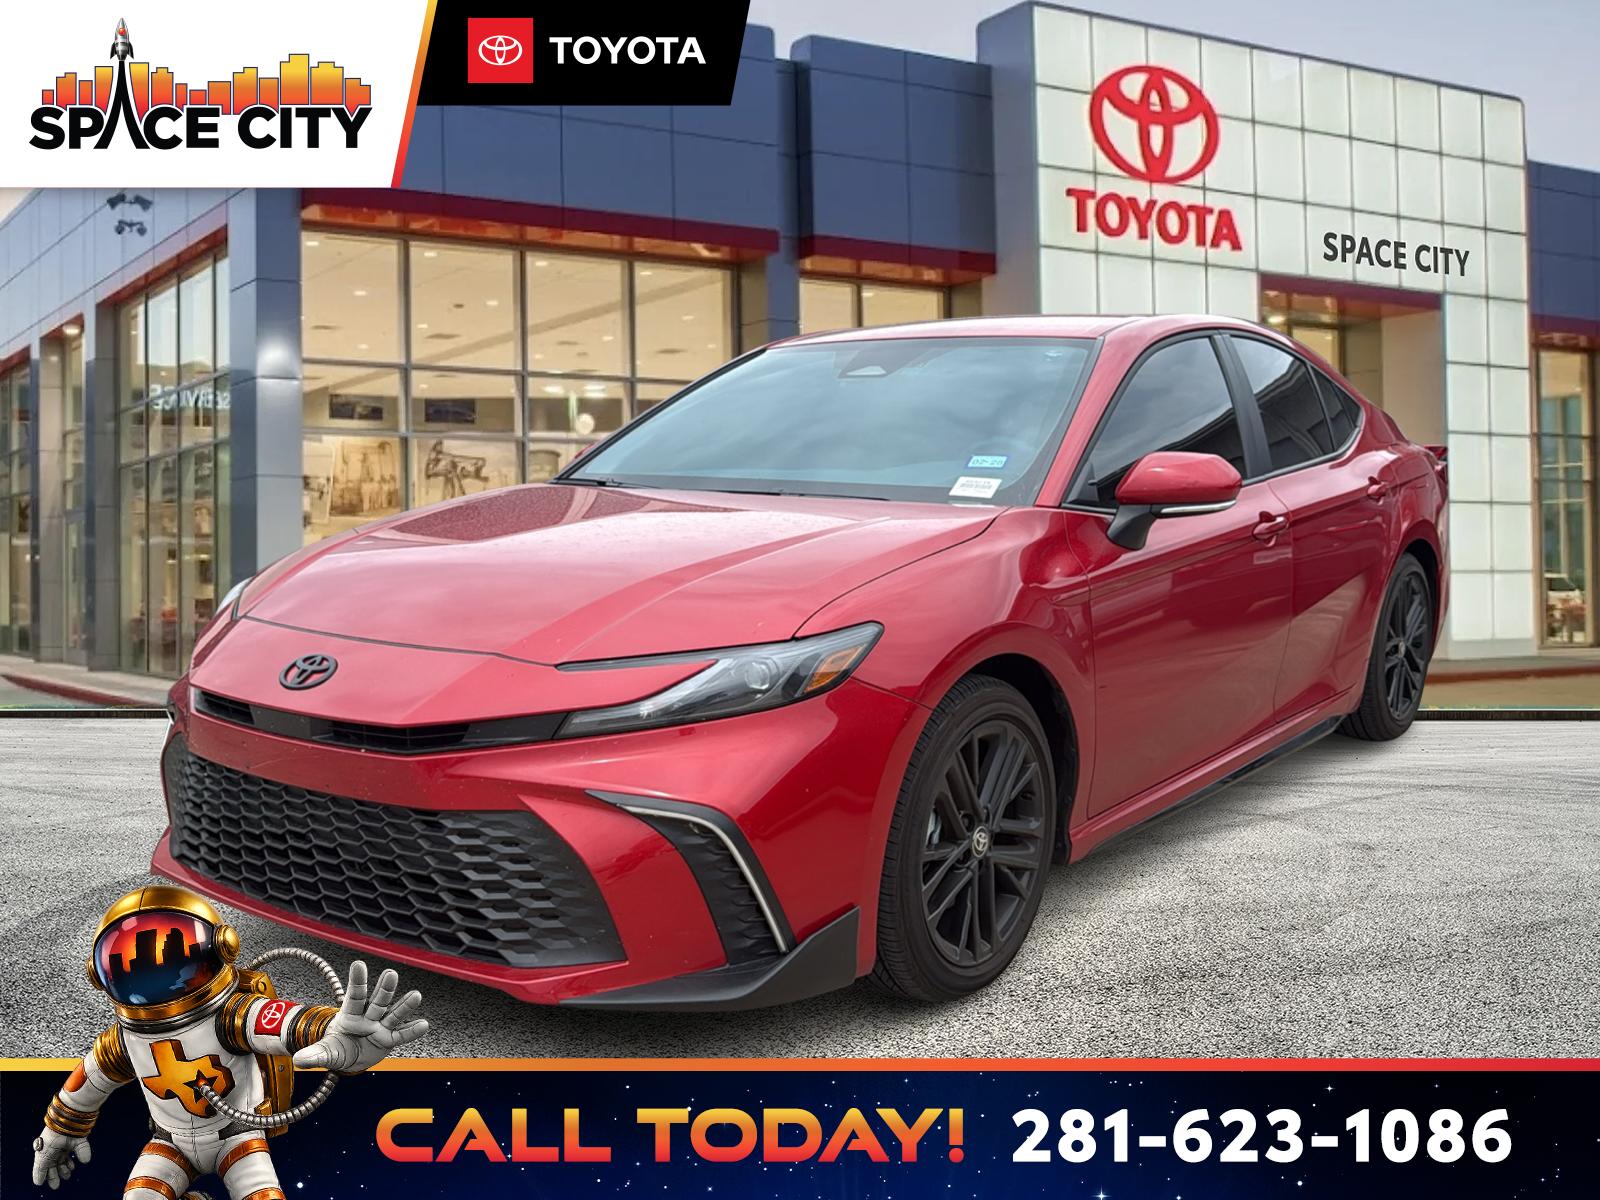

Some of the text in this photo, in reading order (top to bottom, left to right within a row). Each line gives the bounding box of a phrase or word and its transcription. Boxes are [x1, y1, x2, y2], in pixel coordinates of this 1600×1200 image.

[1066, 187, 1242, 251] TOYOTA
[1323, 232, 1470, 277] SPACE CITY
